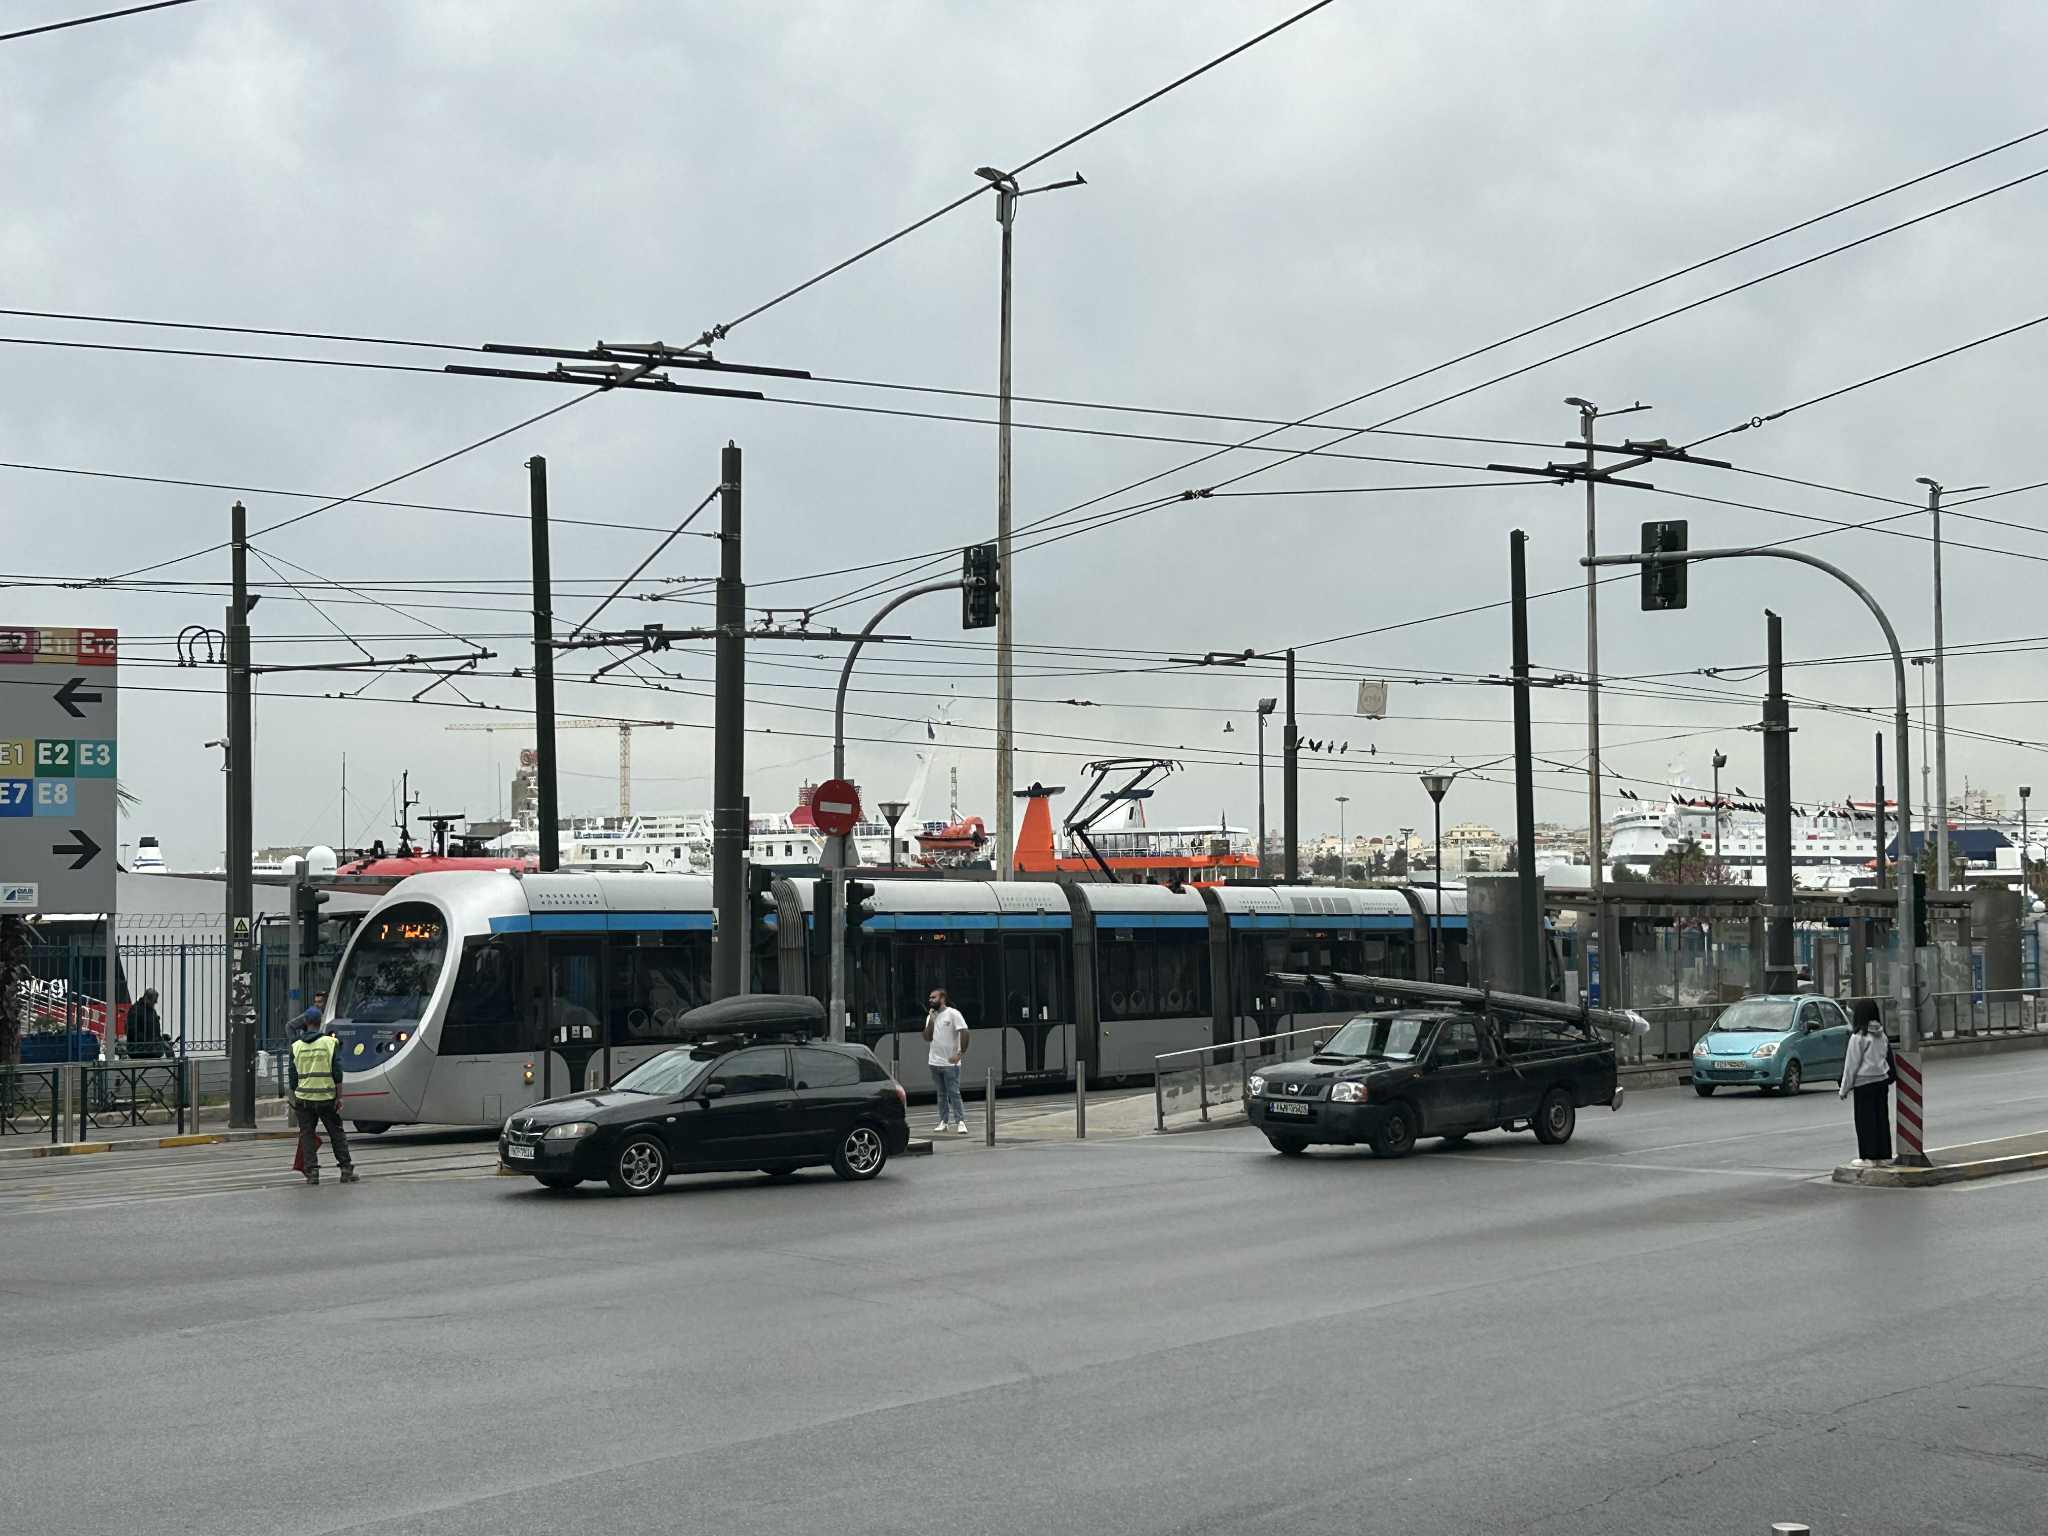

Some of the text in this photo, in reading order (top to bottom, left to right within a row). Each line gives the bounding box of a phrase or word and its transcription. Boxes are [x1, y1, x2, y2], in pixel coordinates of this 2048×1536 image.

[81, 632, 116, 654] E12
[0, 743, 111, 766] E1 E2 E3
[0, 783, 68, 805] E7 E8
